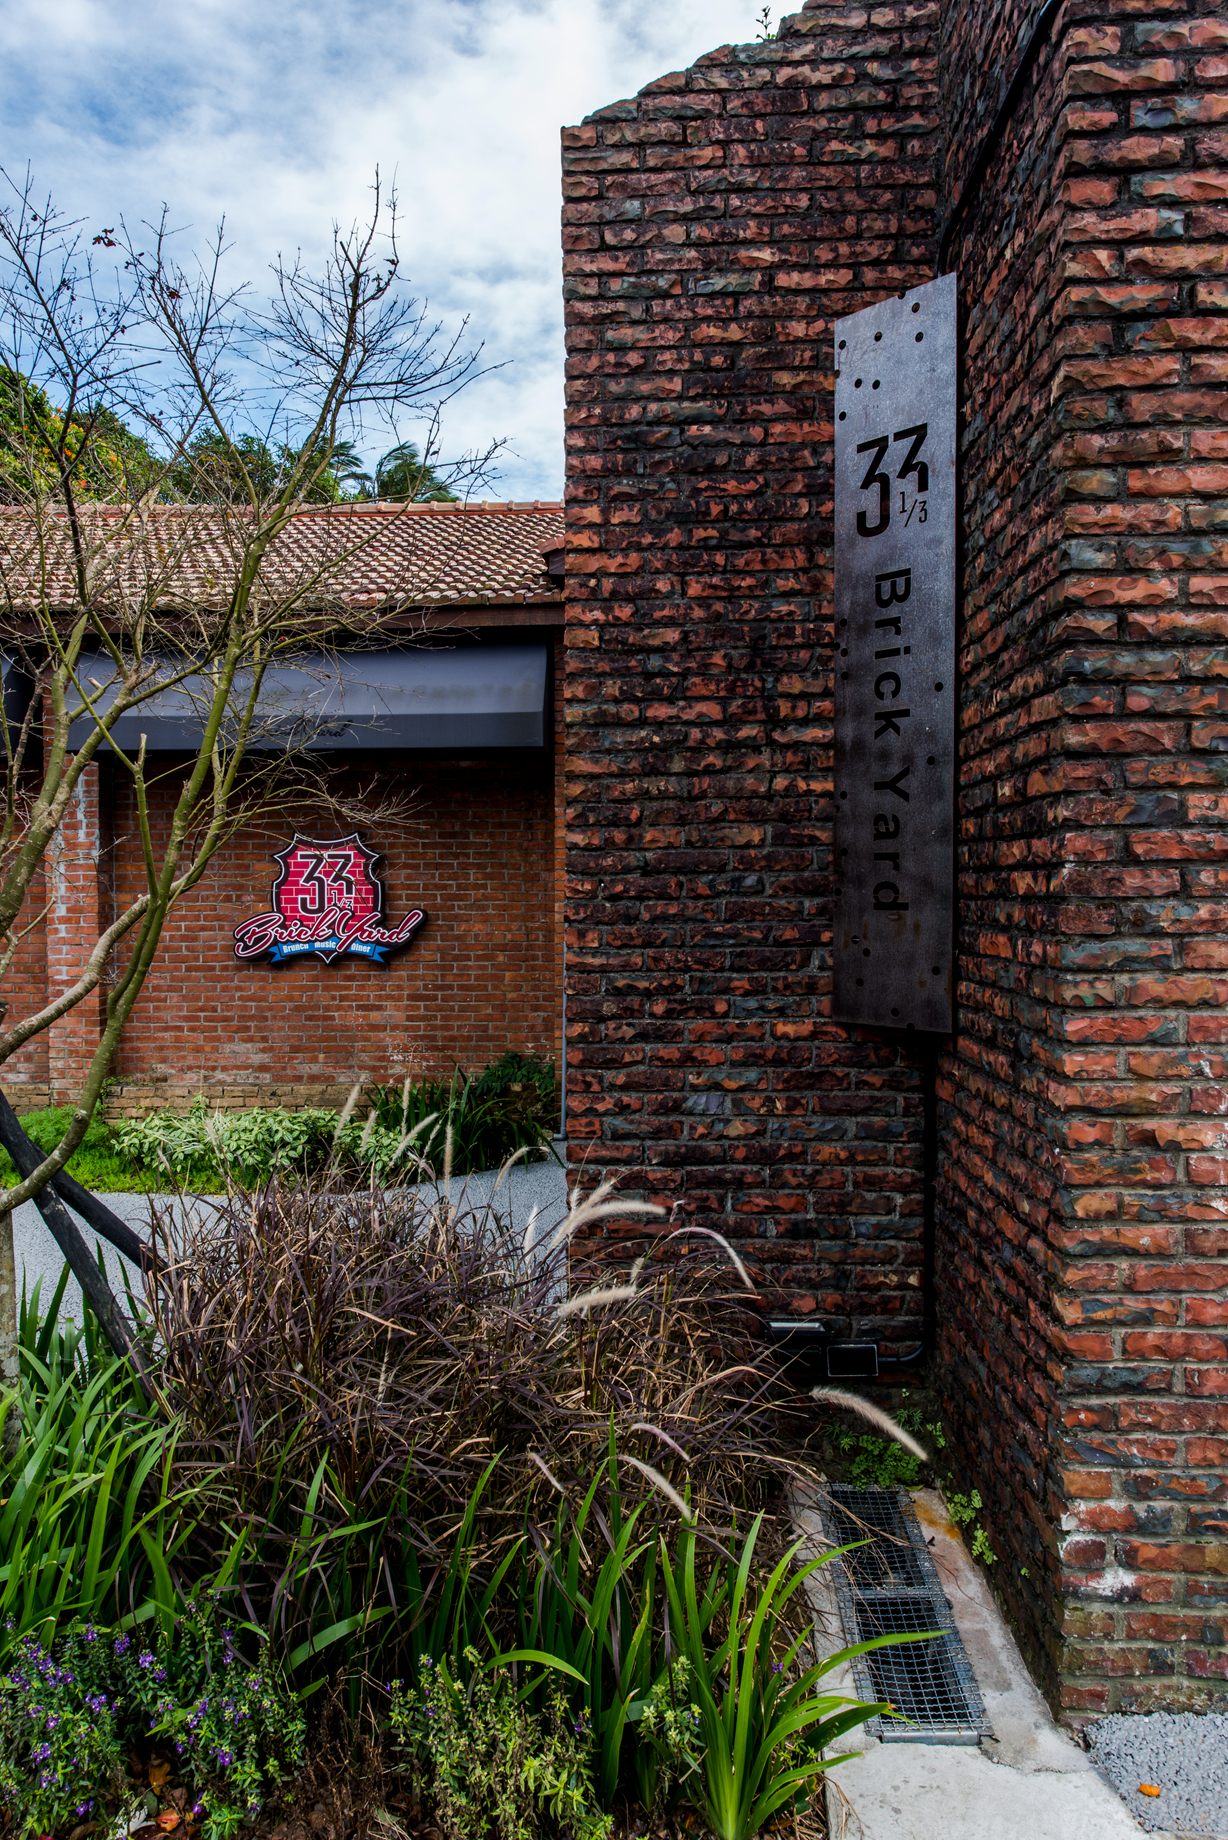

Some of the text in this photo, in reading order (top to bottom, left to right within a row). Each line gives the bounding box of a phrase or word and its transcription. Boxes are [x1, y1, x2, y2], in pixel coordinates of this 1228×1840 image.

[856, 422, 929, 538] 33 1/3
[873, 567, 911, 911] Brick Yard
[297, 851, 356, 916] 33
[234, 906, 424, 957] Brick Yard
[282, 943, 309, 953] Brunch
[351, 943, 371, 953] Diner
